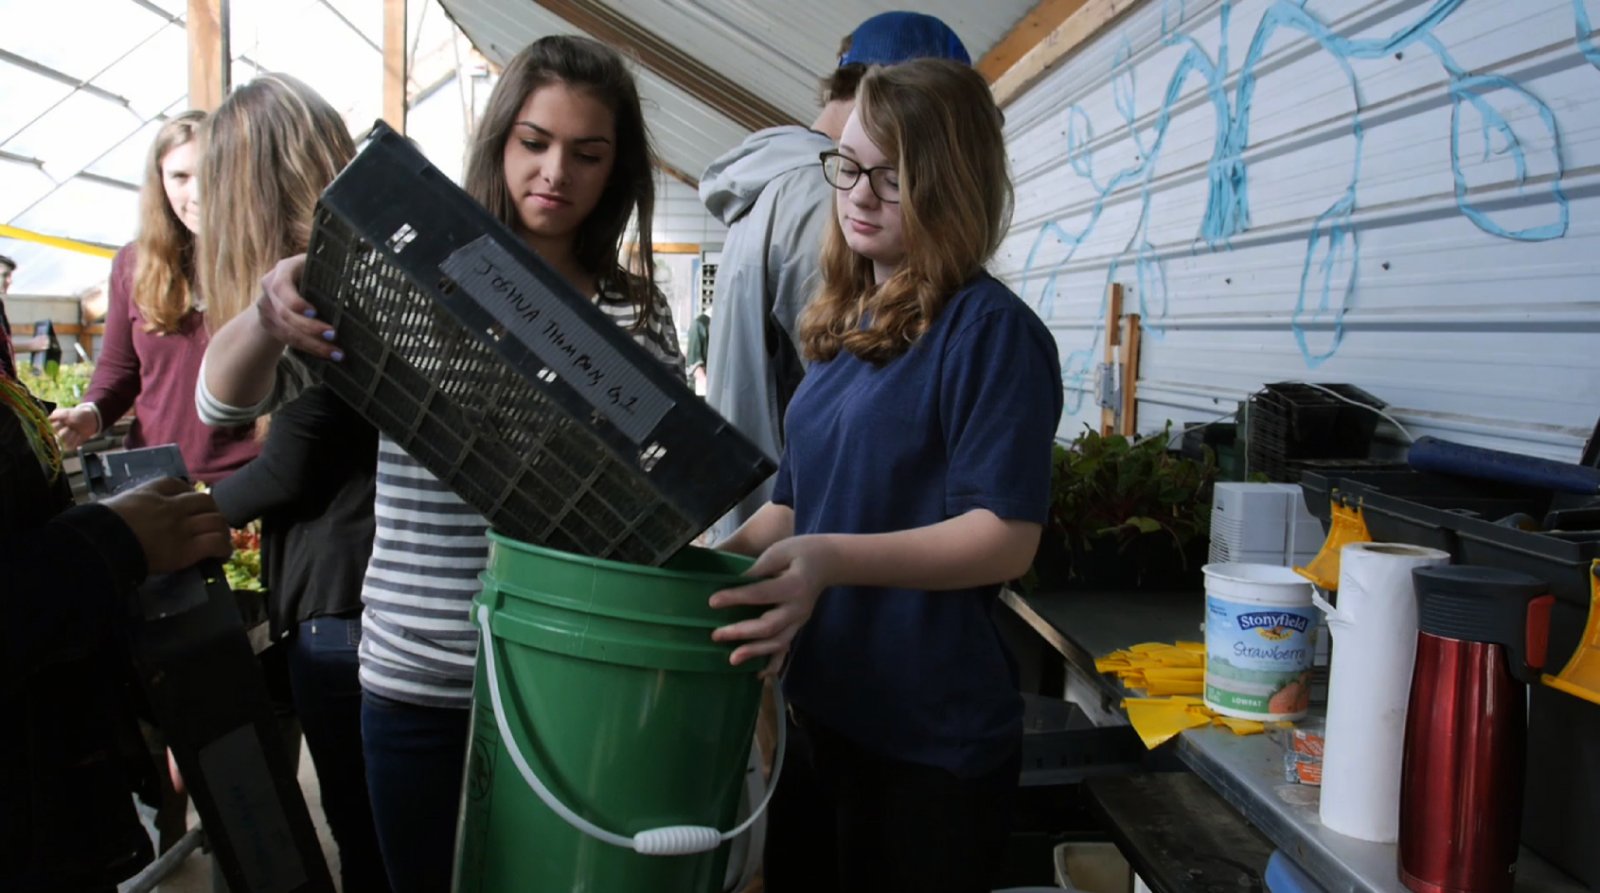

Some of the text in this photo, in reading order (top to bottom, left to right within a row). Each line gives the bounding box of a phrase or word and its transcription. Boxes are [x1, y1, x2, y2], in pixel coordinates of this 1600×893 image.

[474, 254, 541, 323] JOSHUA
[1240, 613, 1307, 631] Stonyfield
[1233, 640, 1306, 665] Strawberry
[1231, 696, 1262, 707] LOWFAT
